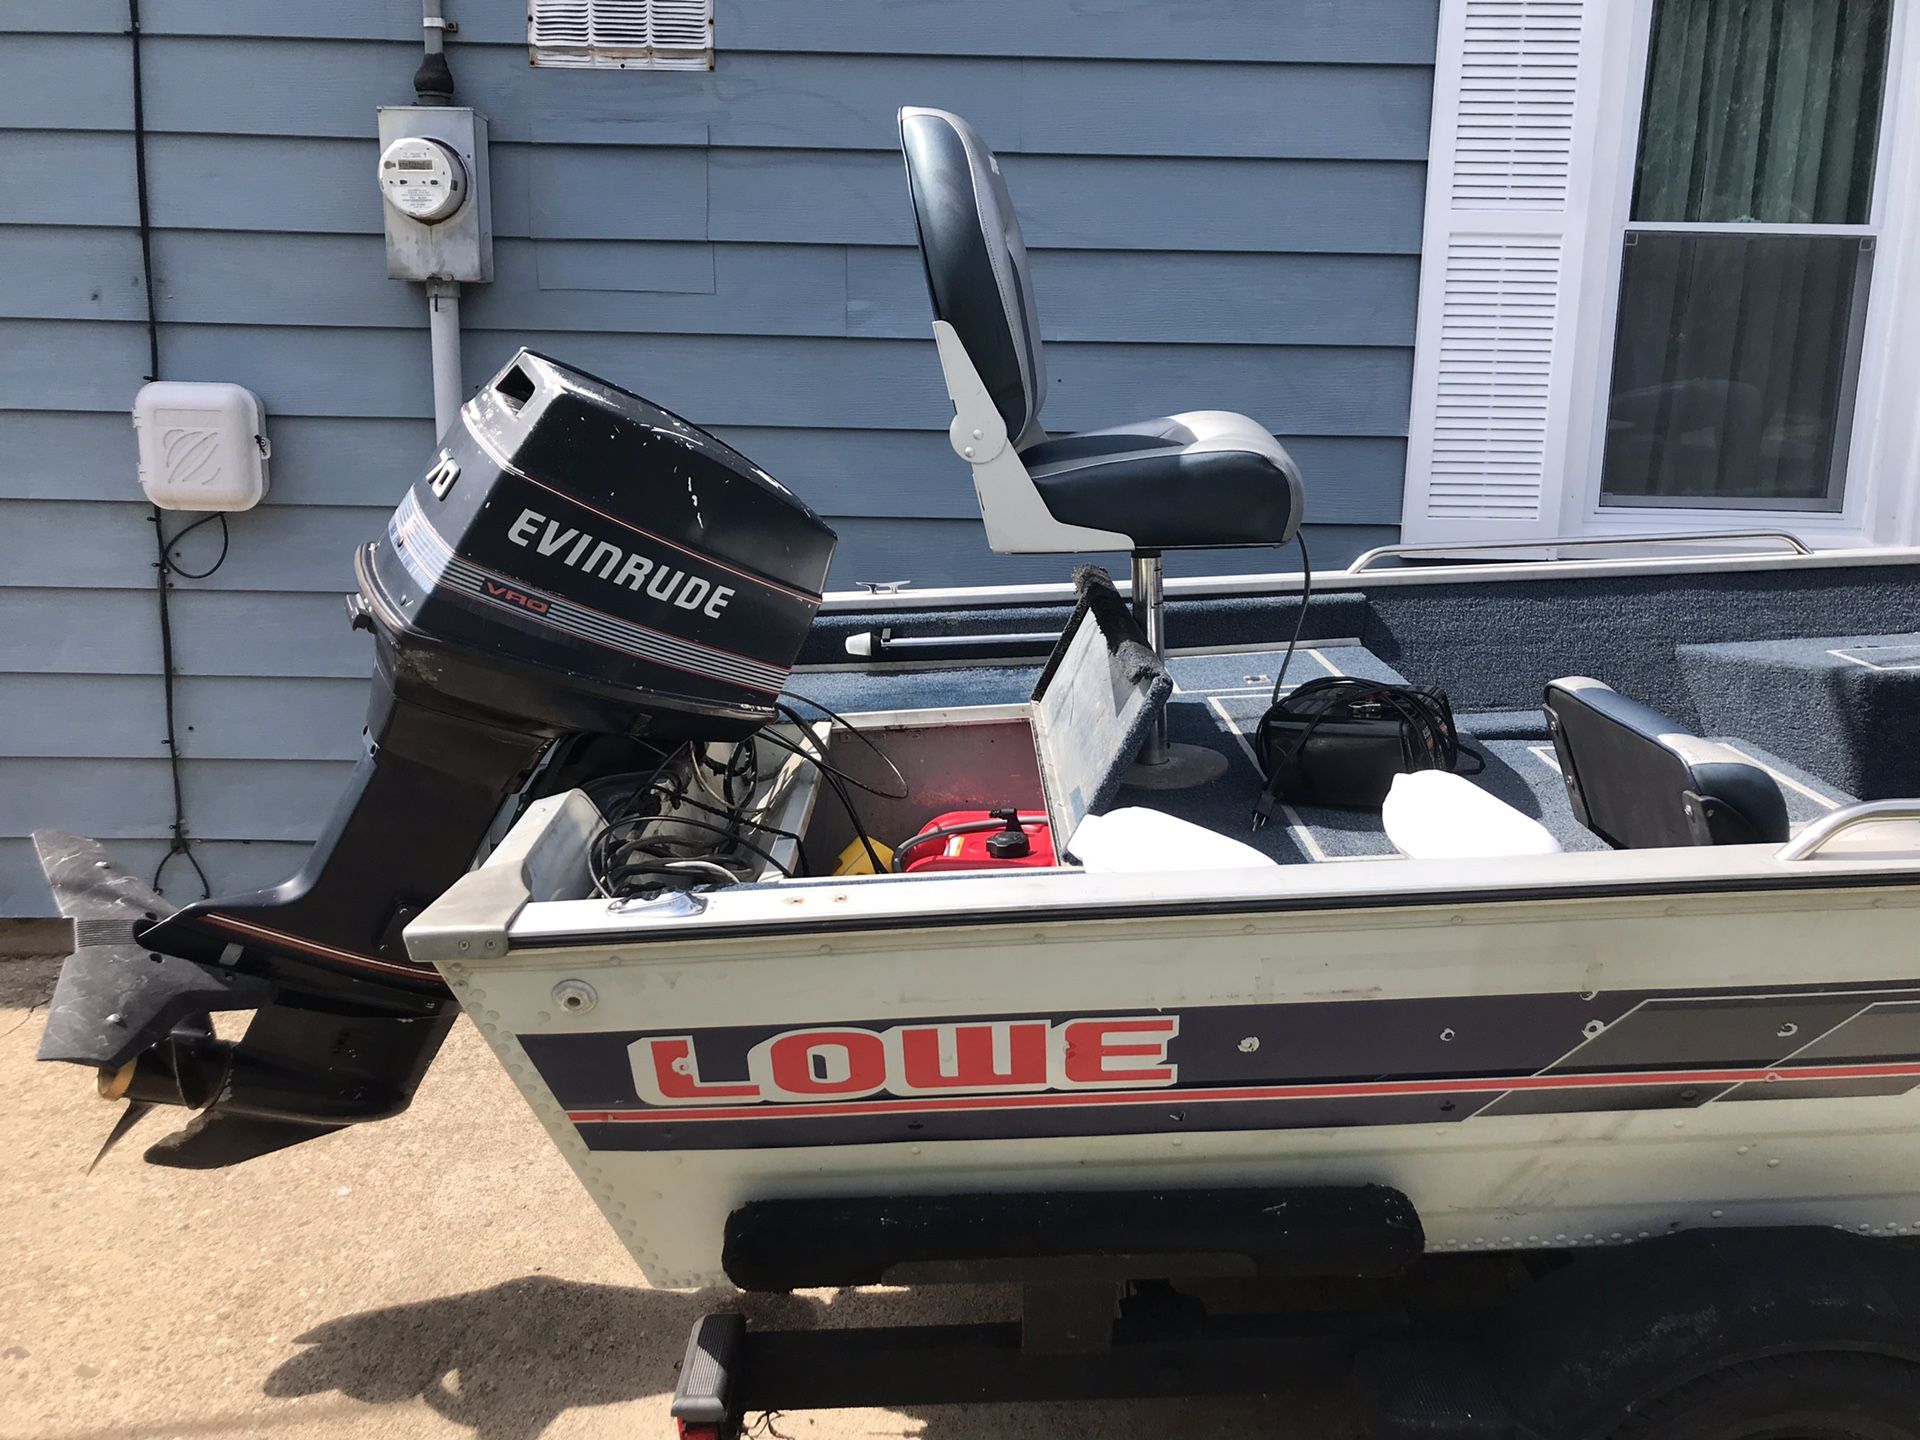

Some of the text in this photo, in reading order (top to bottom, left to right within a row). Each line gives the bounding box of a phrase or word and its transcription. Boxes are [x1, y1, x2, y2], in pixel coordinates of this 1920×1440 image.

[425, 447, 461, 502] 70
[507, 508, 736, 619] EVINRUDE
[627, 1015, 1180, 1105] LOWE
